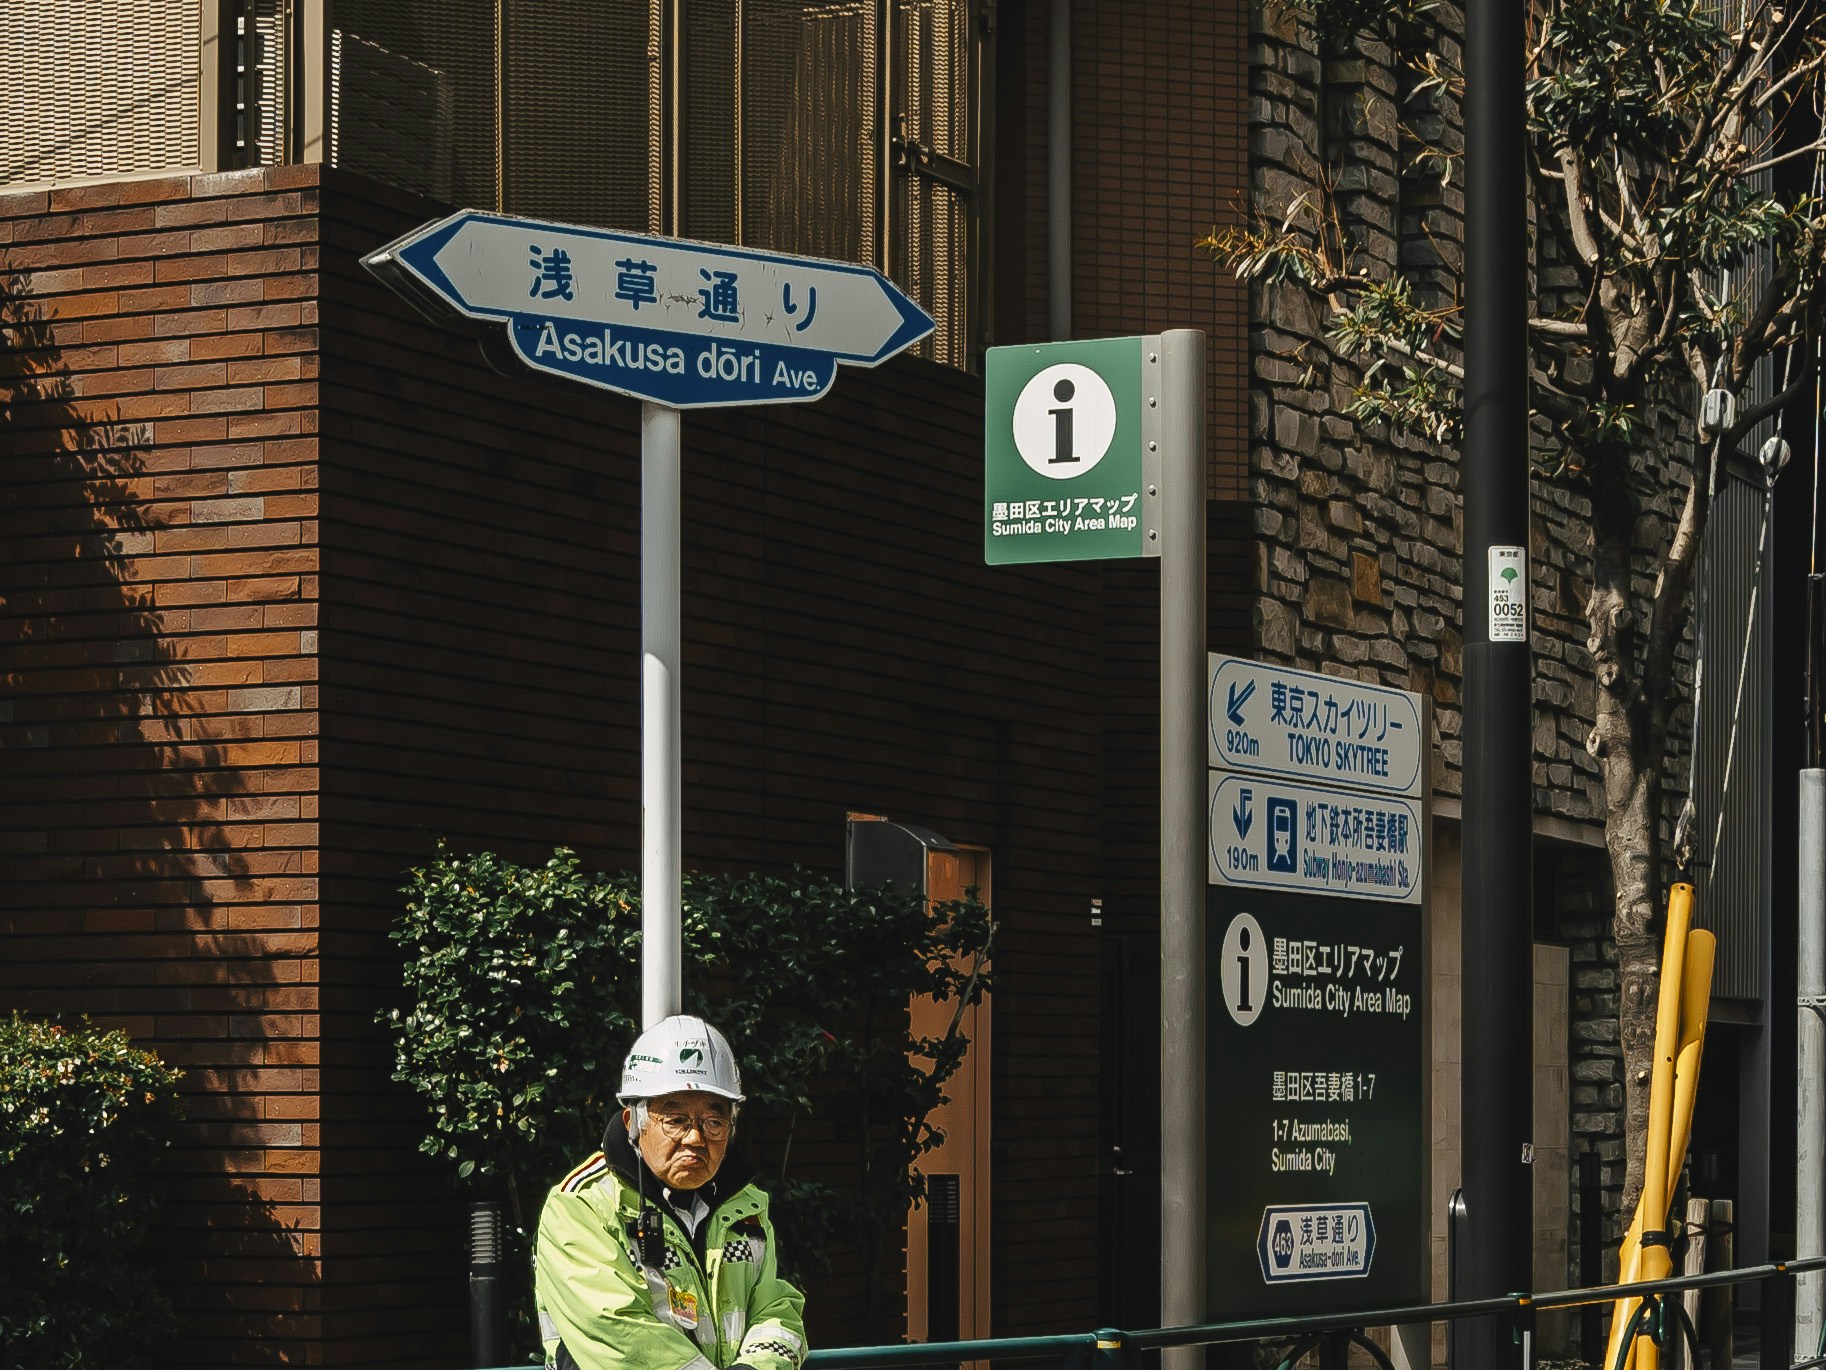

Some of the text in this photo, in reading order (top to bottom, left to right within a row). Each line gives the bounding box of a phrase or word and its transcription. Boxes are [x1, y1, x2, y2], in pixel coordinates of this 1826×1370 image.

[528, 243, 818, 333] 浅草通り
[535, 322, 822, 392] Asakusa dōri Ave.
[991, 493, 1139, 521] 墨田区エリアマップ
[991, 514, 1137, 536] Sumida City Area Map
[1494, 603, 1524, 617] 0052
[1270, 680, 1403, 743] 東京スカイツリー
[1226, 729, 1260, 757] 920m
[1287, 733, 1389, 777] TOKYO SKYTREE
[1305, 800, 1409, 854] 地下鉄本所吾妻橋駅
[1226, 845, 1260, 872] 190m
[1303, 847, 1330, 885] Subway
[1272, 937, 1404, 982] 墨田区エリアマップ
[1272, 981, 1411, 1020] Sumida City Area Map
[1272, 1072, 1376, 1102] 墨田区吾妻橋 1-7
[1272, 1119, 1352, 1146] 1-7 Azumabasi,
[1271, 1147, 1336, 1176] Sumida City
[1275, 1232, 1292, 1256] 463
[1300, 1214, 1359, 1245] 浅草通り
[1299, 1246, 1361, 1269] Asakusa-dori Ave.
